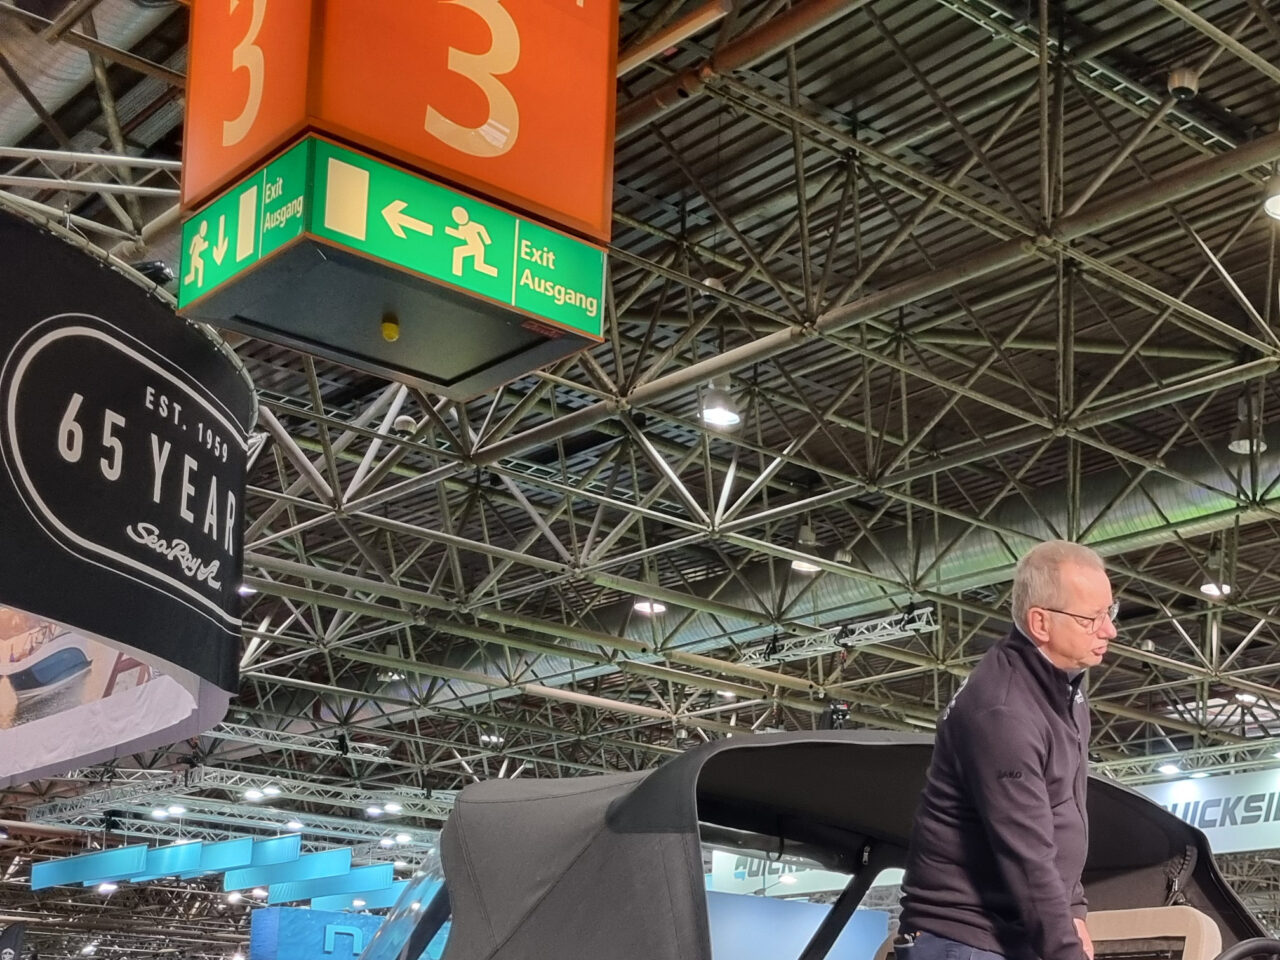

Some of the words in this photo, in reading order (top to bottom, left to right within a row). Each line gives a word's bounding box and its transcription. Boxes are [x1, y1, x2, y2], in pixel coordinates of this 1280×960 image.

[222, 0, 267, 147] 3
[424, 0, 521, 158] 3
[264, 194, 304, 233] Ausgang
[265, 176, 284, 204] Exit
[520, 240, 556, 270] Exit
[520, 269, 598, 317] Ausgang
[58, 392, 126, 482] 65
[145, 386, 187, 431] EST.
[198, 422, 228, 463] 1959
